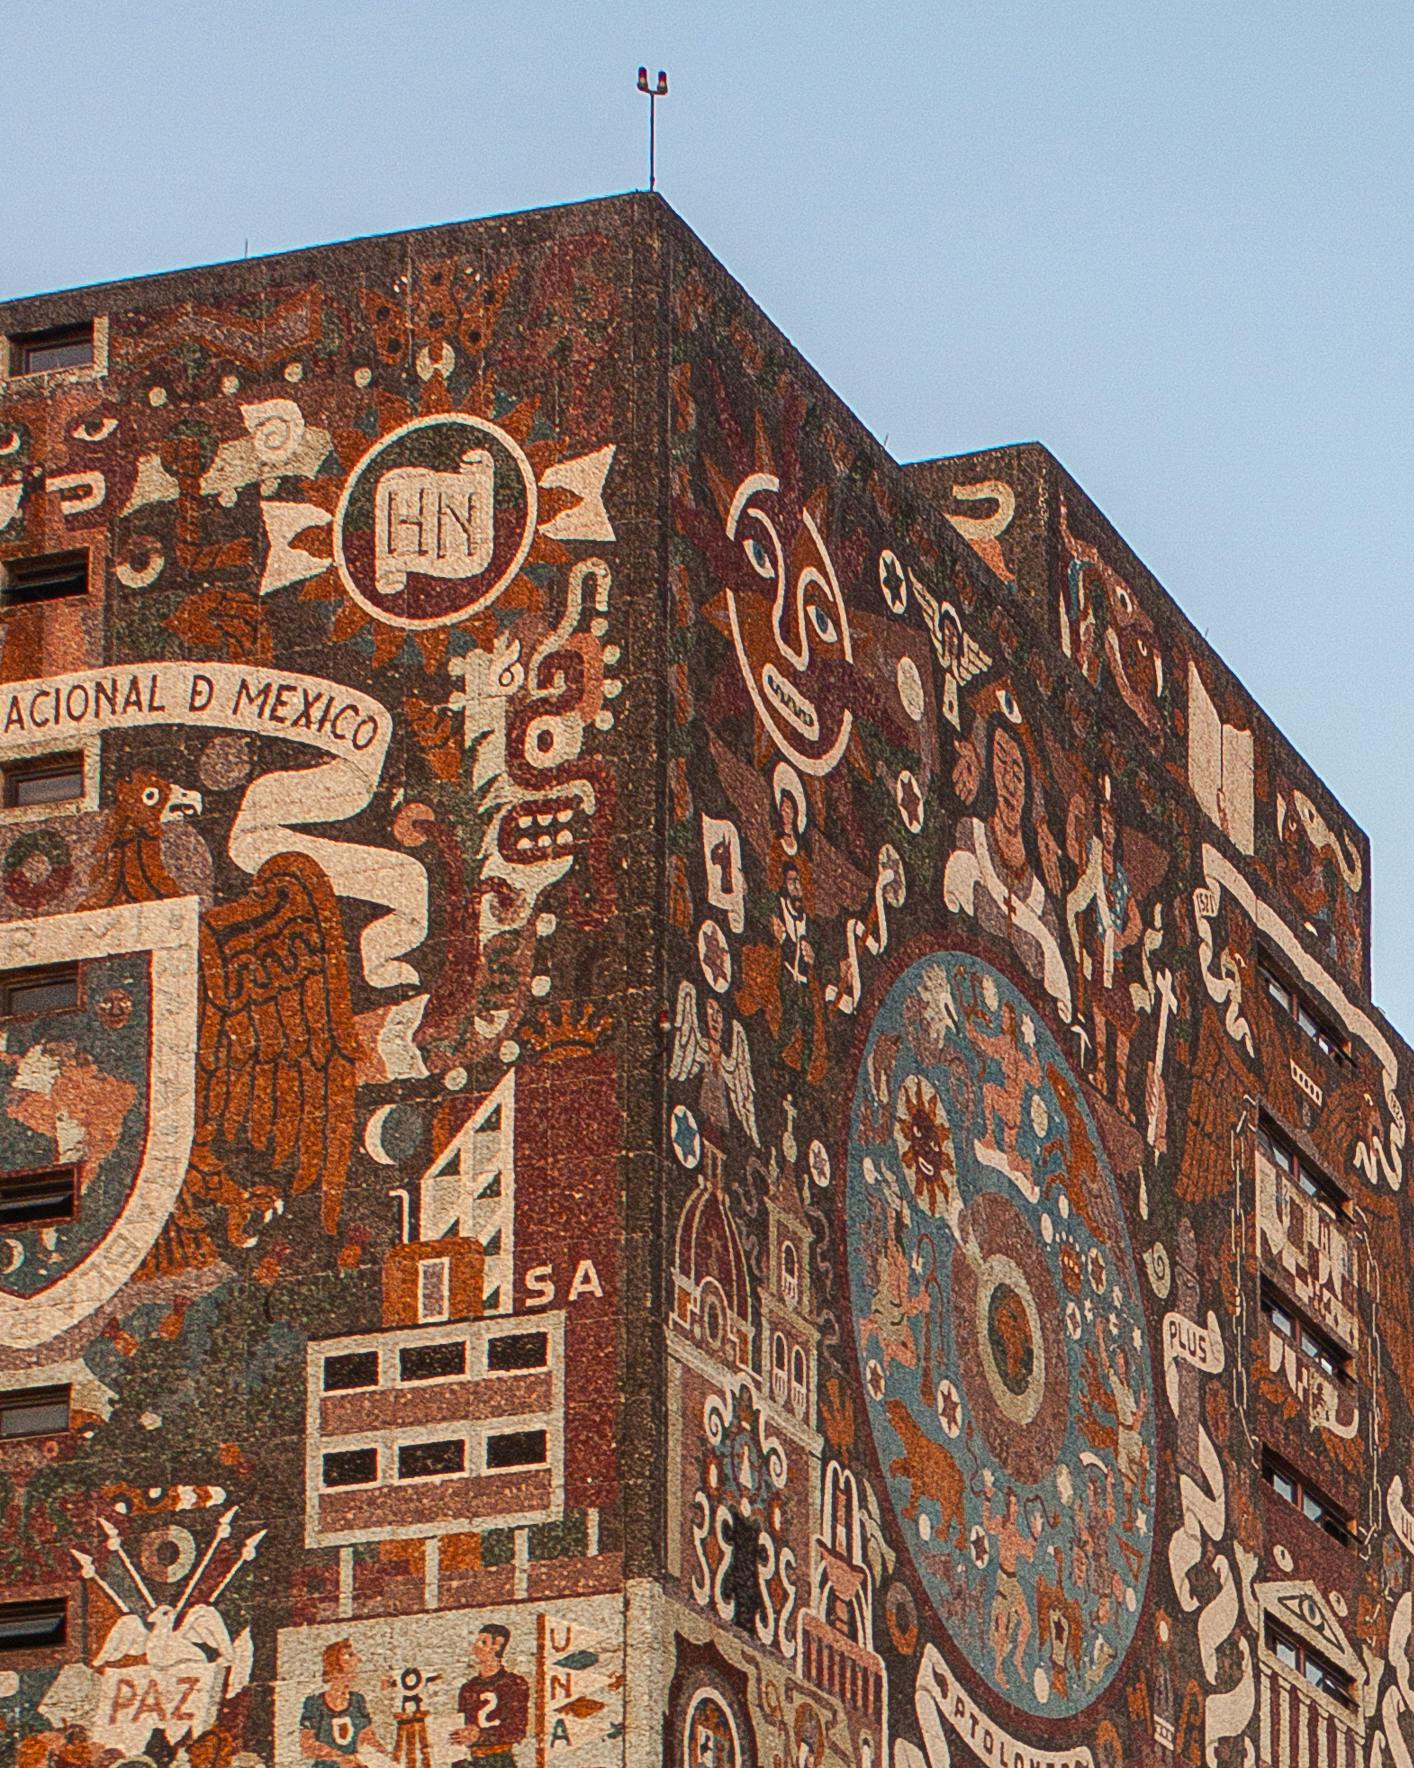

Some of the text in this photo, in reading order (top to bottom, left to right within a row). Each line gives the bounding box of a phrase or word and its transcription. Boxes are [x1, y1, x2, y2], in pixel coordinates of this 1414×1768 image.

[232, 677, 381, 752] MEXICO
[1169, 1320, 1207, 1364] PLUS
[109, 1675, 201, 1727] PAZ
